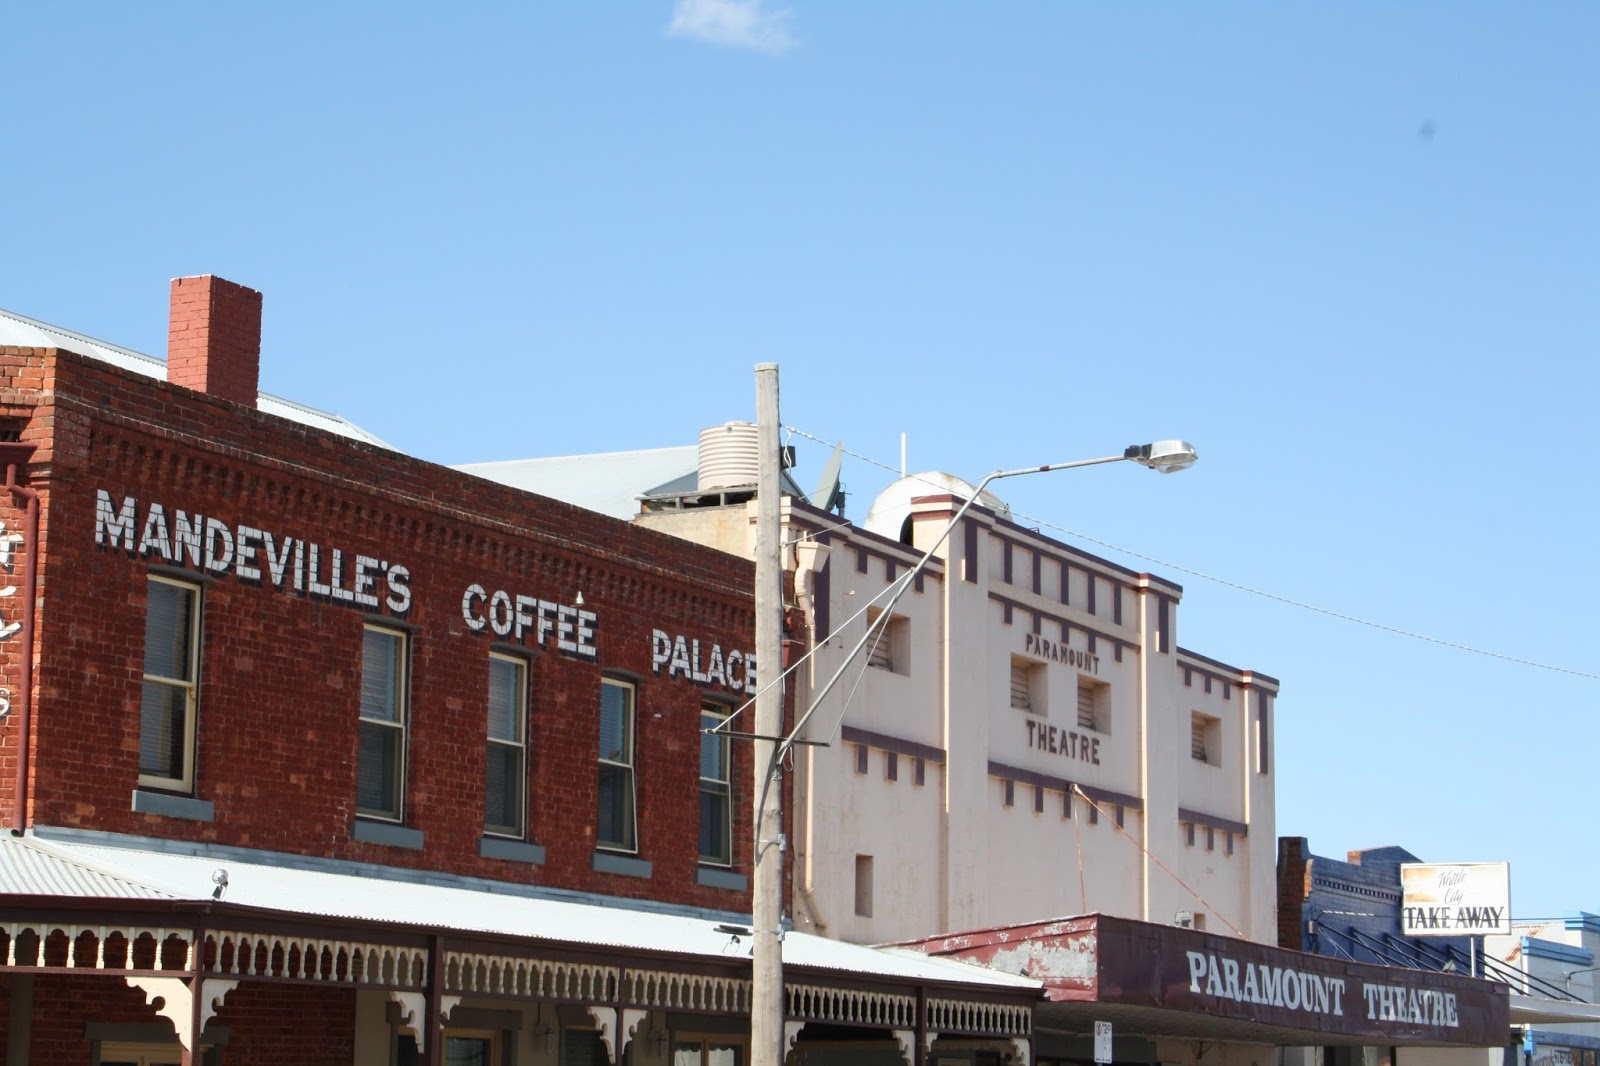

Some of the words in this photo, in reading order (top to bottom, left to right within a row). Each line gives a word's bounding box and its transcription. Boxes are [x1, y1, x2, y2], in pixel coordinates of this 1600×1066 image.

[95, 489, 412, 613] MANDEVILLE'S
[462, 584, 597, 657] COFFEE
[652, 628, 757, 696] PALACE
[1026, 634, 1100, 674] PARAMOUNT
[1026, 719, 1101, 765] THEATRE
[1404, 906, 1451, 929] TAKE
[1454, 906, 1504, 929] AWAY
[1445, 888, 1464, 906] City
[1186, 951, 1345, 1016] PARAMOUNT
[1363, 983, 1459, 1028] THEATRE
